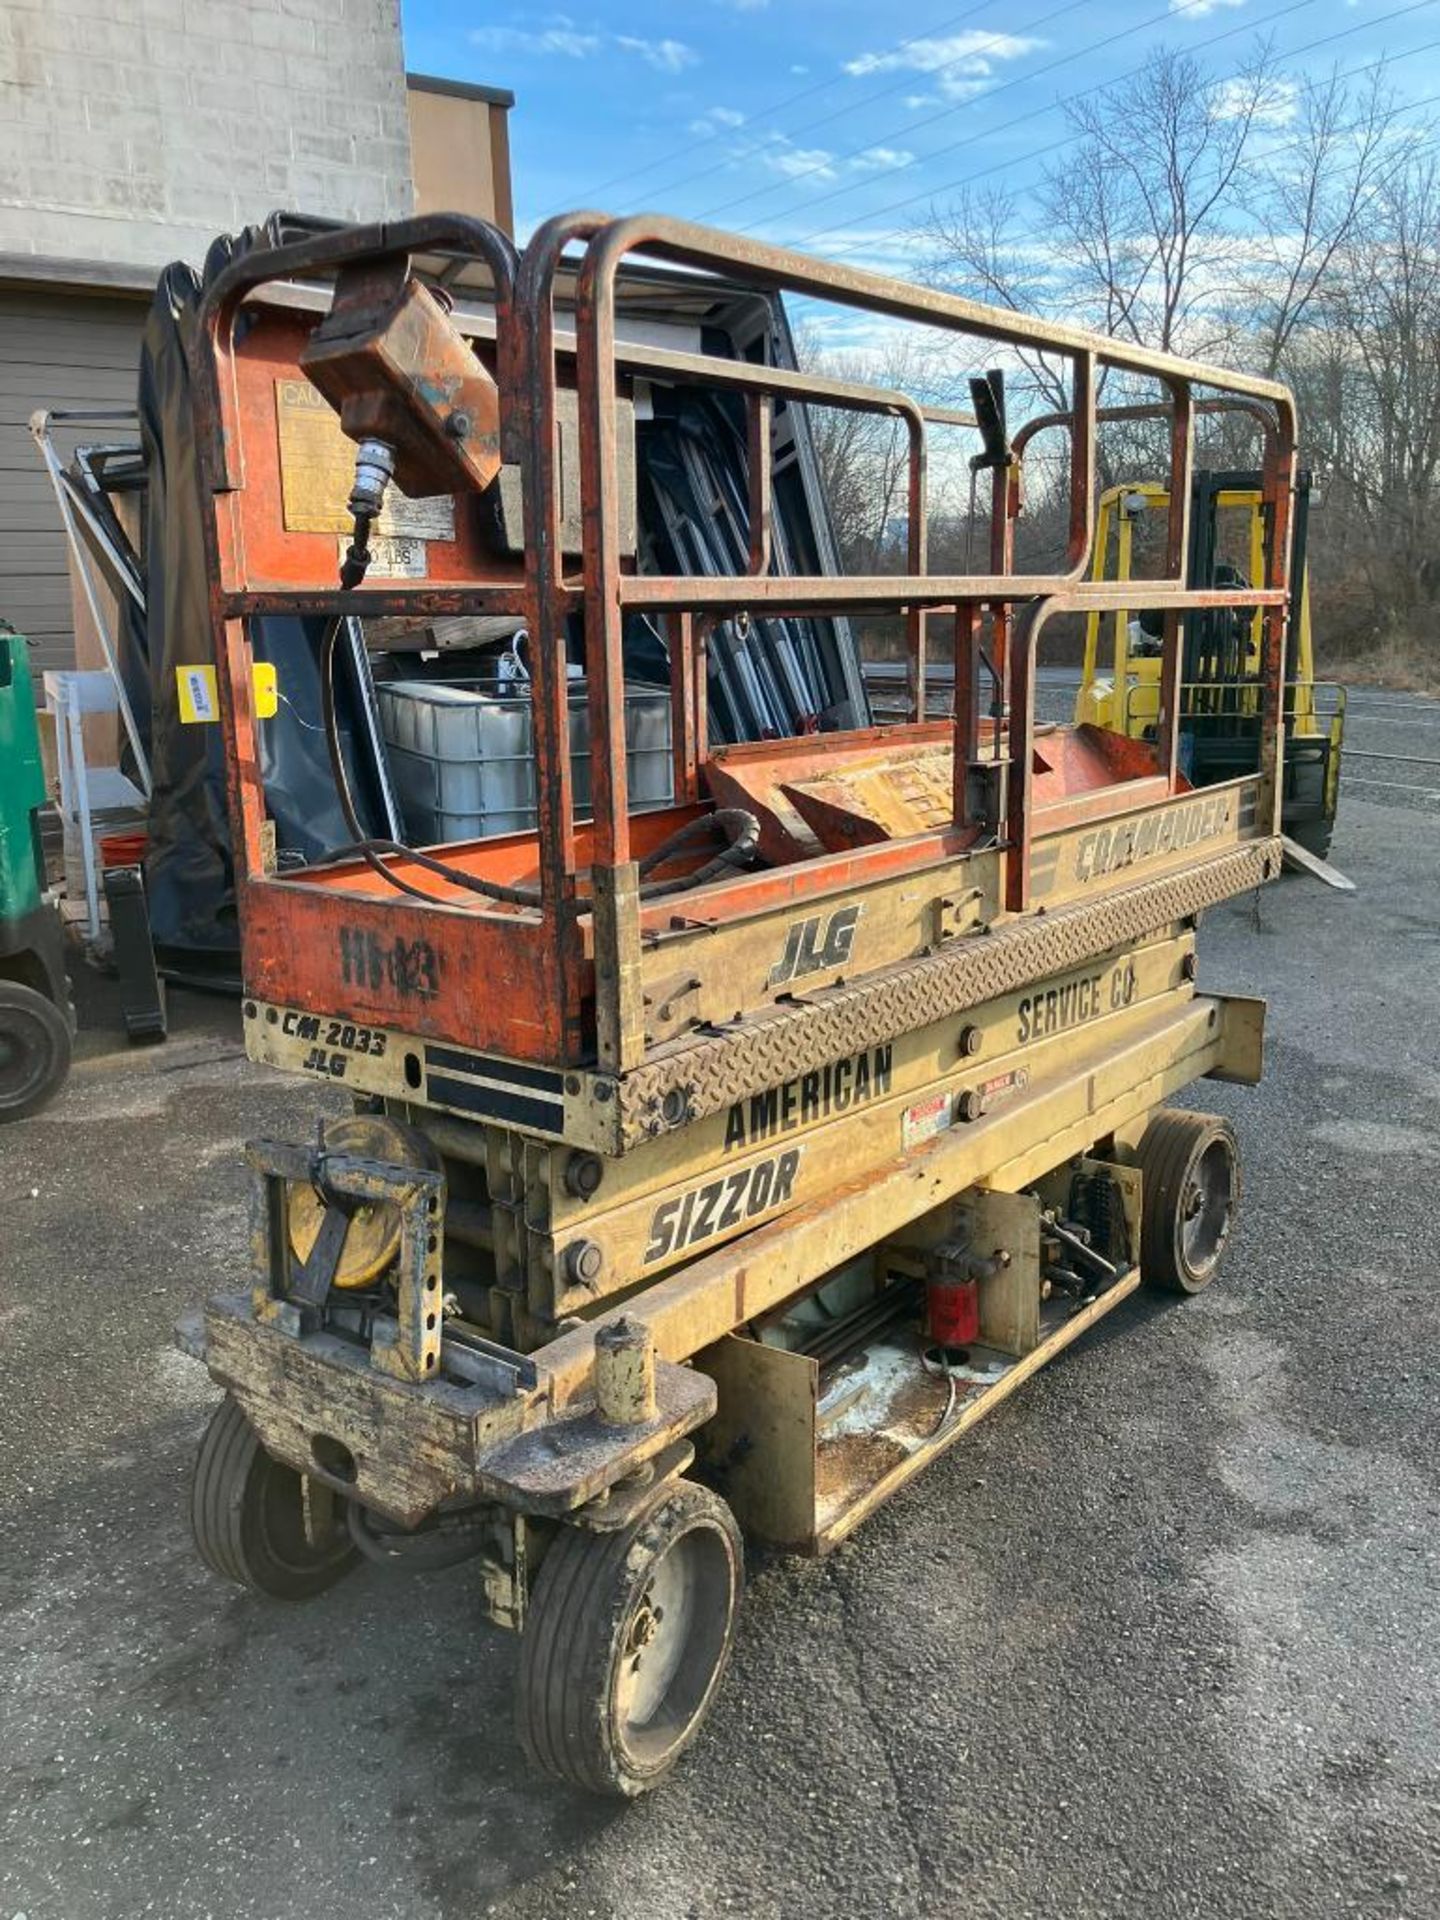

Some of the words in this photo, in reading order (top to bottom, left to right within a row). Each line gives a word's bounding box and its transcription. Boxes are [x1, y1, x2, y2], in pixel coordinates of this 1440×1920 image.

[768, 903, 862, 986] JLG
[282, 1012, 387, 1057] CM-2033
[1017, 975, 1102, 1043] SERVICE
[303, 1047, 347, 1077] JLG
[723, 1043, 892, 1154] AMERICAN
[644, 1148, 800, 1264] SIZZOR
